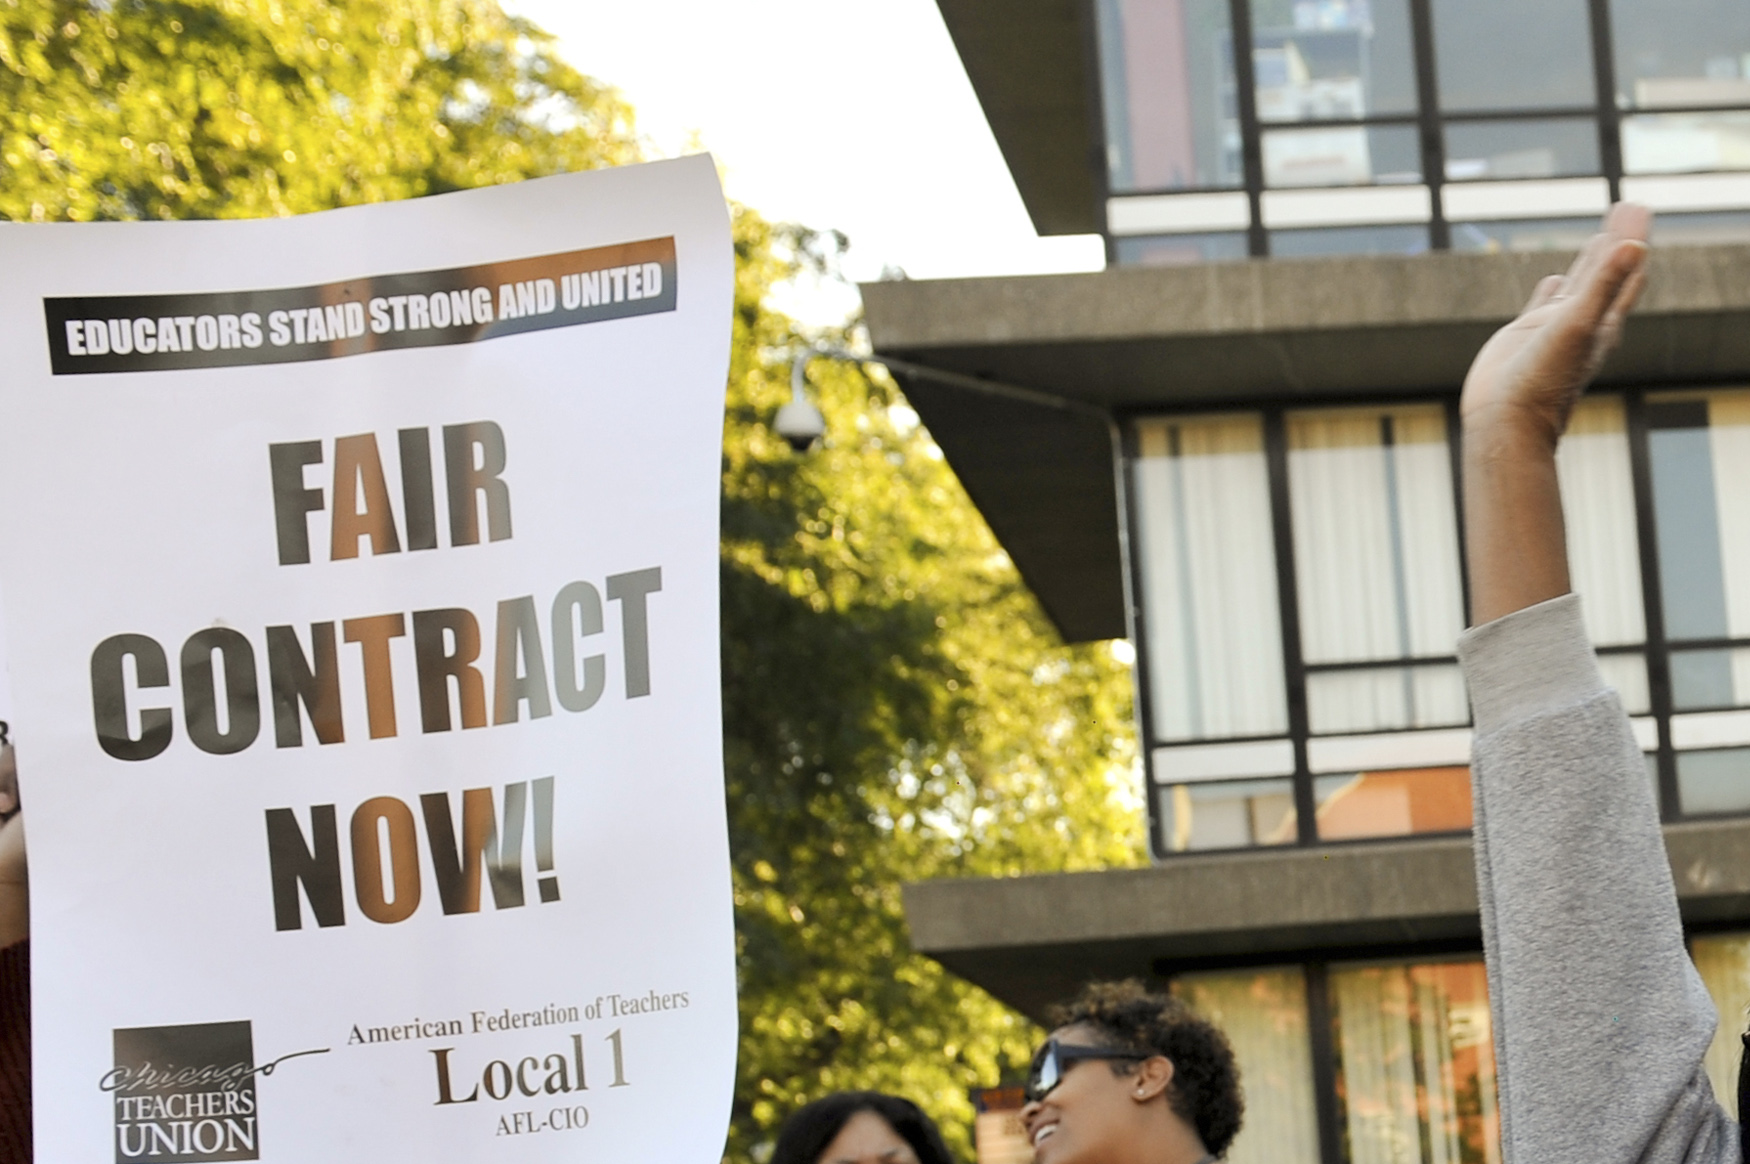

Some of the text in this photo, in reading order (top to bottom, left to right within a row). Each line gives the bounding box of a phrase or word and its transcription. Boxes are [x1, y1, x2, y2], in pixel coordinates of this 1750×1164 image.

[65, 261, 663, 356] EDUCATORS STAND STRONG AND UNITED
[268, 419, 513, 567] FAIR
[90, 566, 663, 761] CONTRACT
[264, 775, 561, 932] NOW!
[347, 989, 690, 1046] American Federation of Teachers
[116, 1088, 254, 1121] TEACHERS
[428, 1027, 630, 1106] Local 1
[116, 1116, 256, 1157] UNION
[495, 1105, 589, 1137] AFL-CIO
